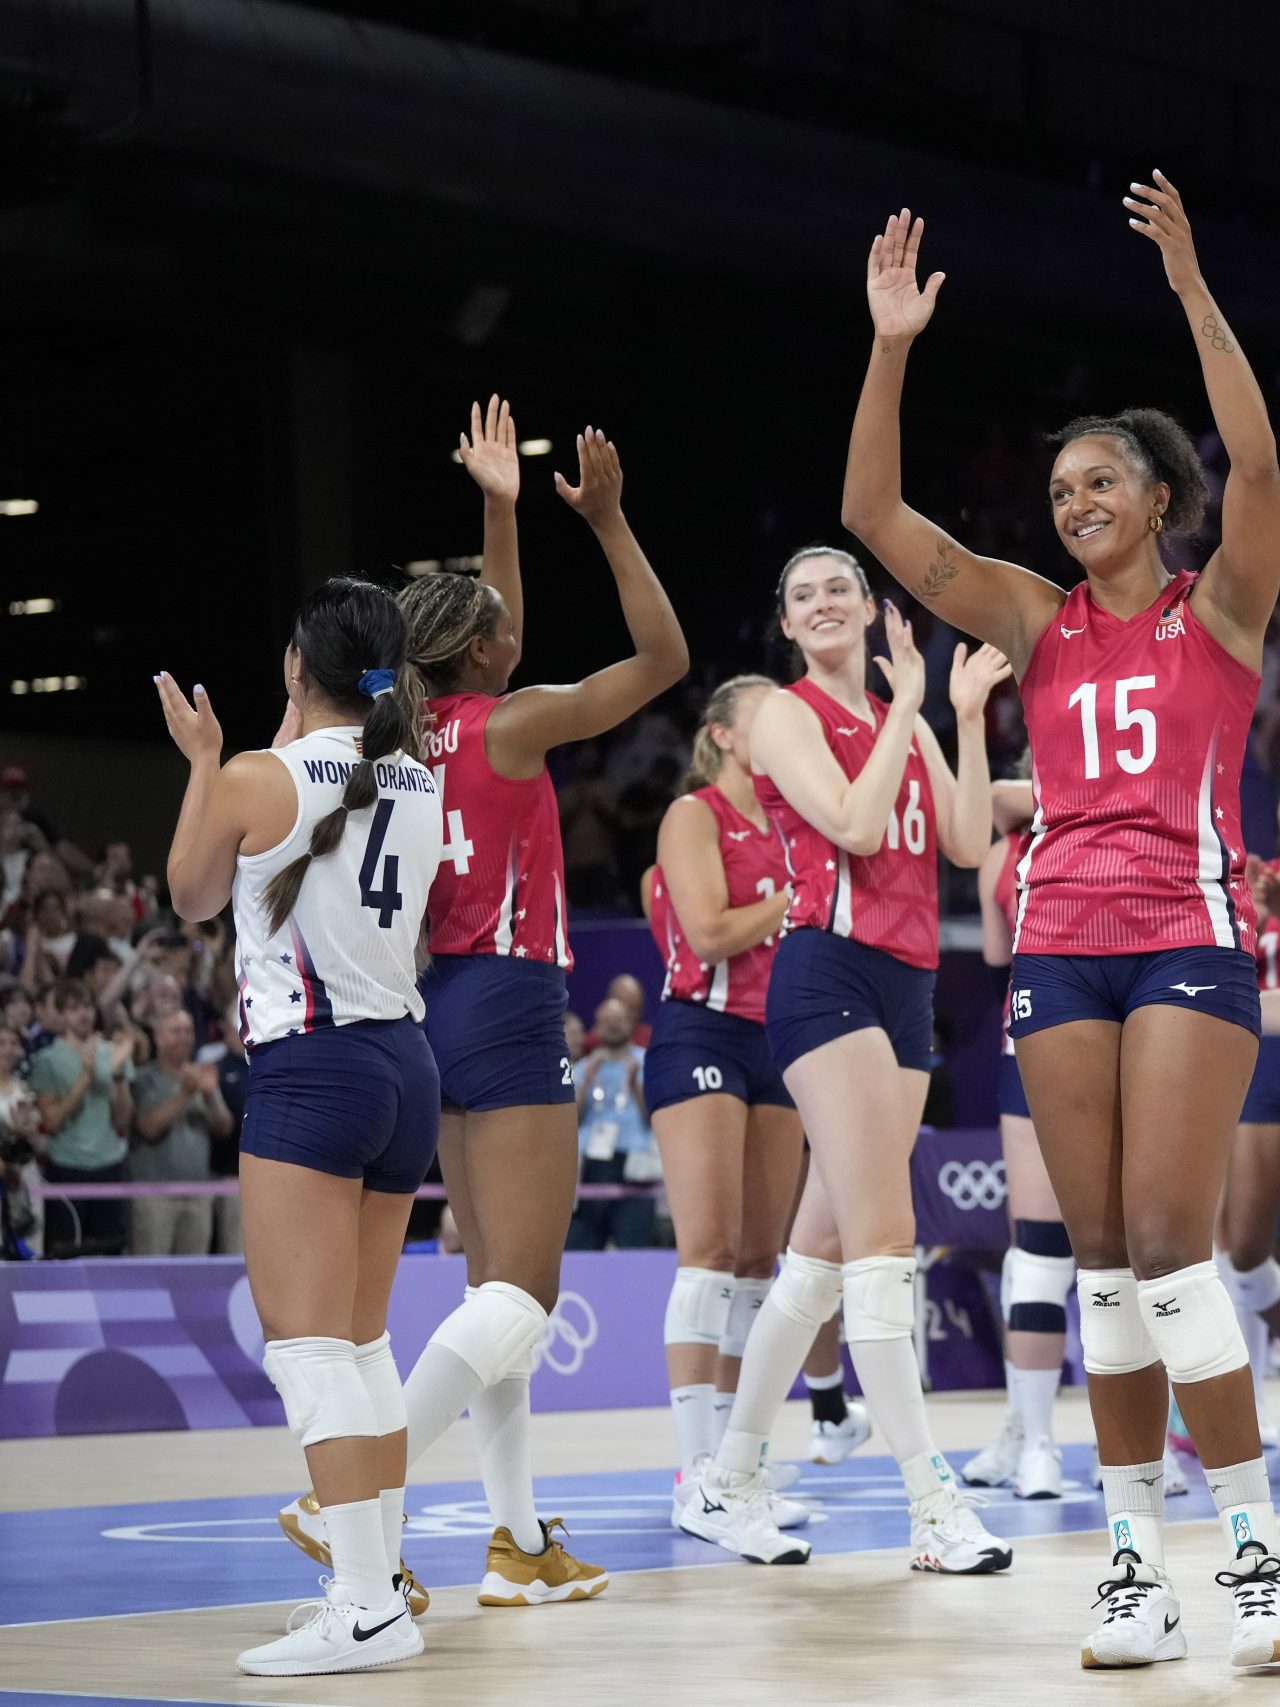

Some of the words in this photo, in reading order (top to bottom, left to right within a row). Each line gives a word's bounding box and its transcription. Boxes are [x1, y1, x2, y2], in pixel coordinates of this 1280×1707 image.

[1155, 617, 1186, 641] USA
[1068, 674, 1157, 780] 15
[358, 798, 403, 929] 4
[1011, 989, 1032, 1020] 15
[692, 1066, 723, 1091] 10
